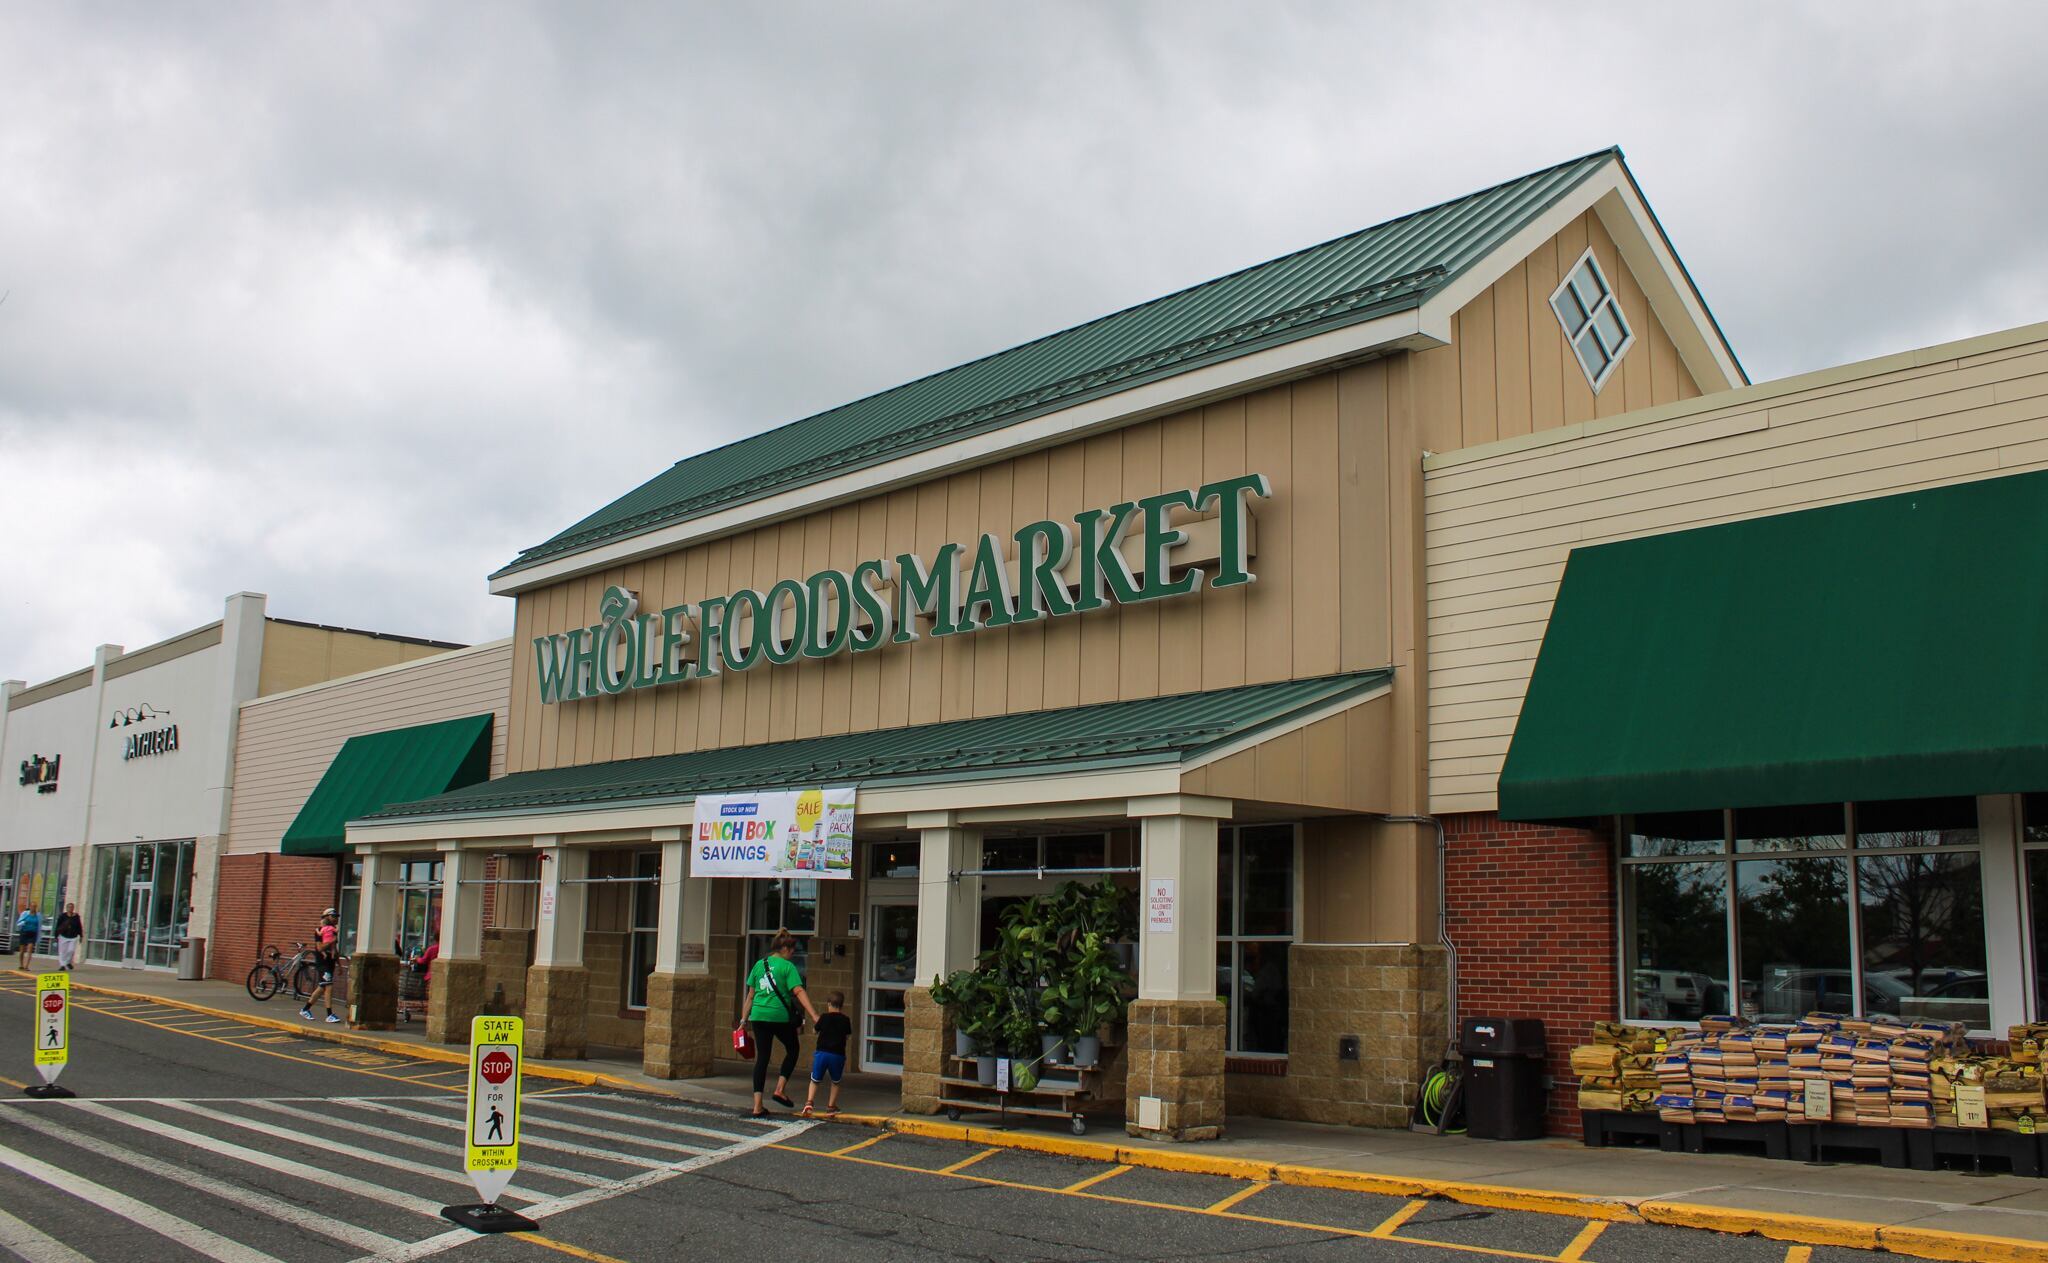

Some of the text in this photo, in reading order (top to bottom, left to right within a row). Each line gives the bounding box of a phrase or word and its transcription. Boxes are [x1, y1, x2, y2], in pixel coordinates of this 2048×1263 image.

[533, 474, 1271, 704] WHOLE FOODS MARKET
[126, 725, 179, 760] ATHLETA
[797, 801, 822, 817] SALE
[700, 820, 776, 841] LUNCH BOX
[829, 822, 852, 833] PACK
[702, 845, 767, 861] SAVINGS
[1157, 888, 1166, 896] NO
[44, 1000, 62, 1008] STOP
[483, 1021, 514, 1031] STATE
[487, 1033, 509, 1042] LAW
[483, 1062, 510, 1074] STOP
[487, 1093, 503, 1101] FOR
[481, 1149, 505, 1157] WITHIN
[472, 1158, 513, 1167] CROSSWALK
